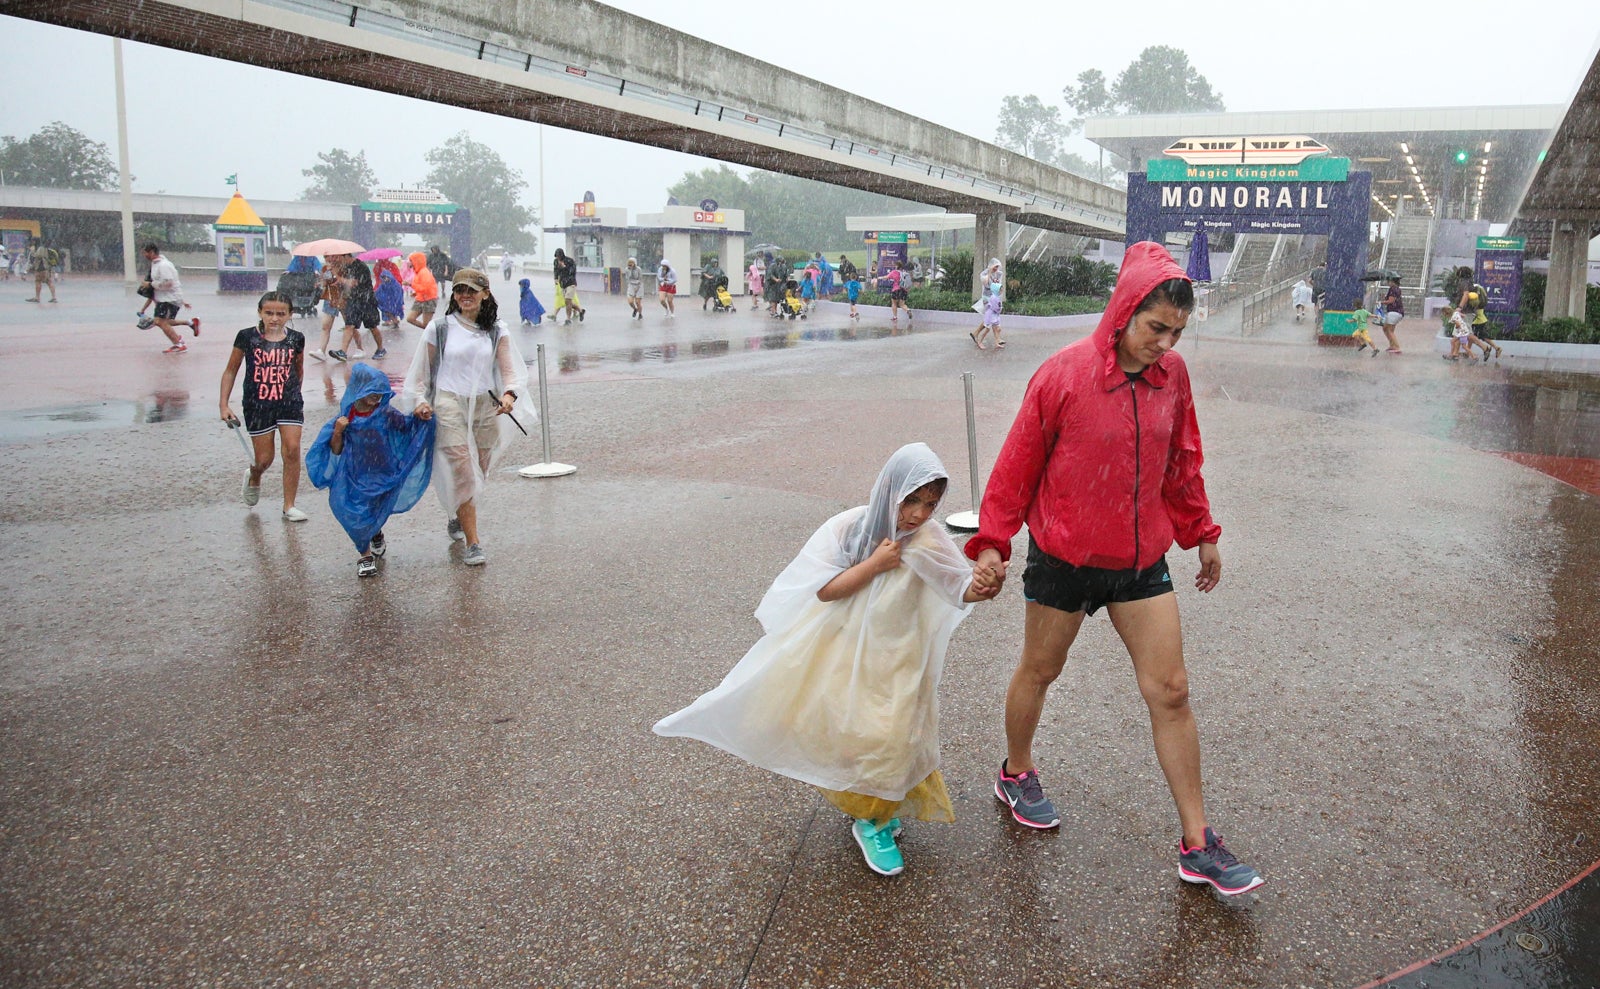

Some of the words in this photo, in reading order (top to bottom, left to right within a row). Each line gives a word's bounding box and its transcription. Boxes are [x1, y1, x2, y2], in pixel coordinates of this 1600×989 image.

[1187, 168, 1228, 178] Magic
[1235, 168, 1299, 178] Kingdom
[1161, 186, 1328, 208] MONORAIL
[365, 212, 453, 224] FERRYBOAT
[1203, 220, 1232, 228] Kingdom
[1271, 221, 1301, 229] Kingdom
[254, 348, 294, 364] SMILE
[254, 366, 291, 383] EVERY
[258, 383, 284, 400] DAY
